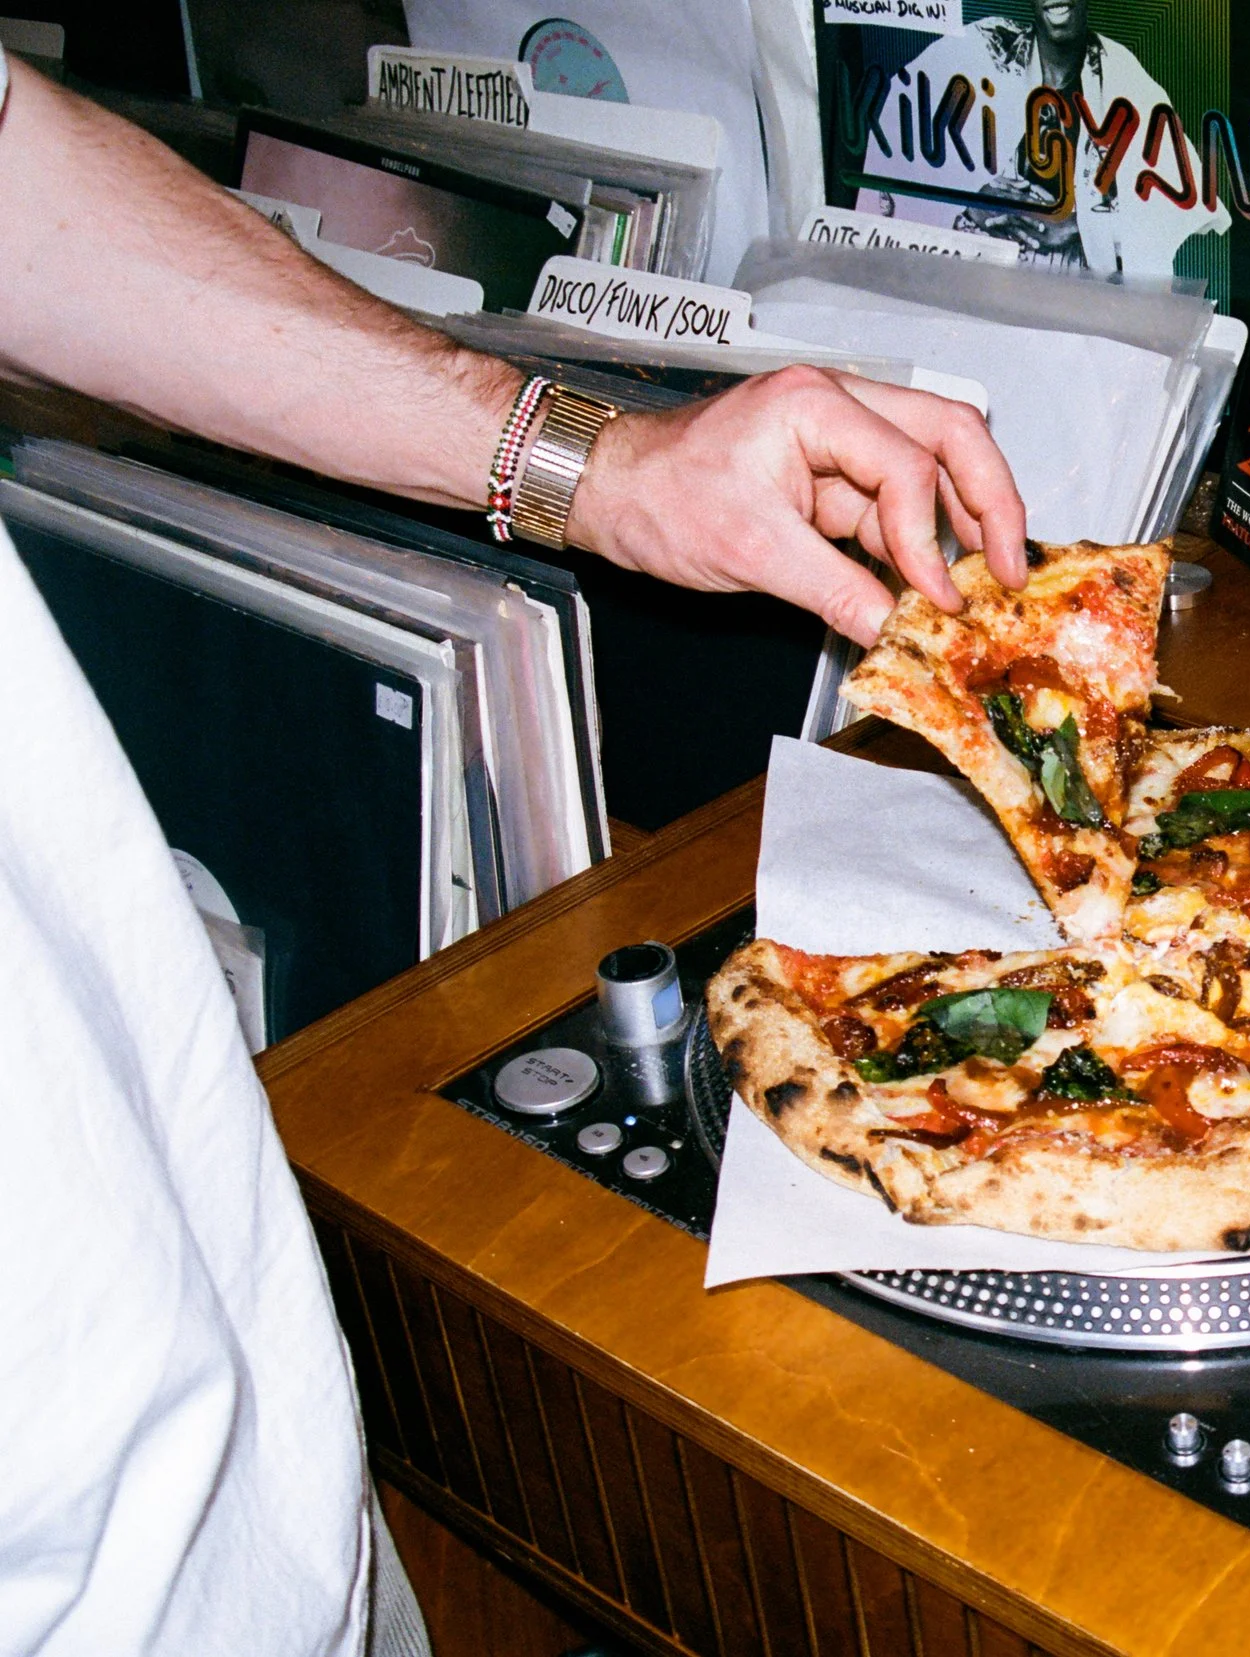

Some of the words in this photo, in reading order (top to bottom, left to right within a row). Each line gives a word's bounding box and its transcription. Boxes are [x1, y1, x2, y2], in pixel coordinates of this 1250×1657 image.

[897, 0, 923, 18] DIG
[926, 4, 947, 22] IN!
[1226, 497, 1241, 517] THE
